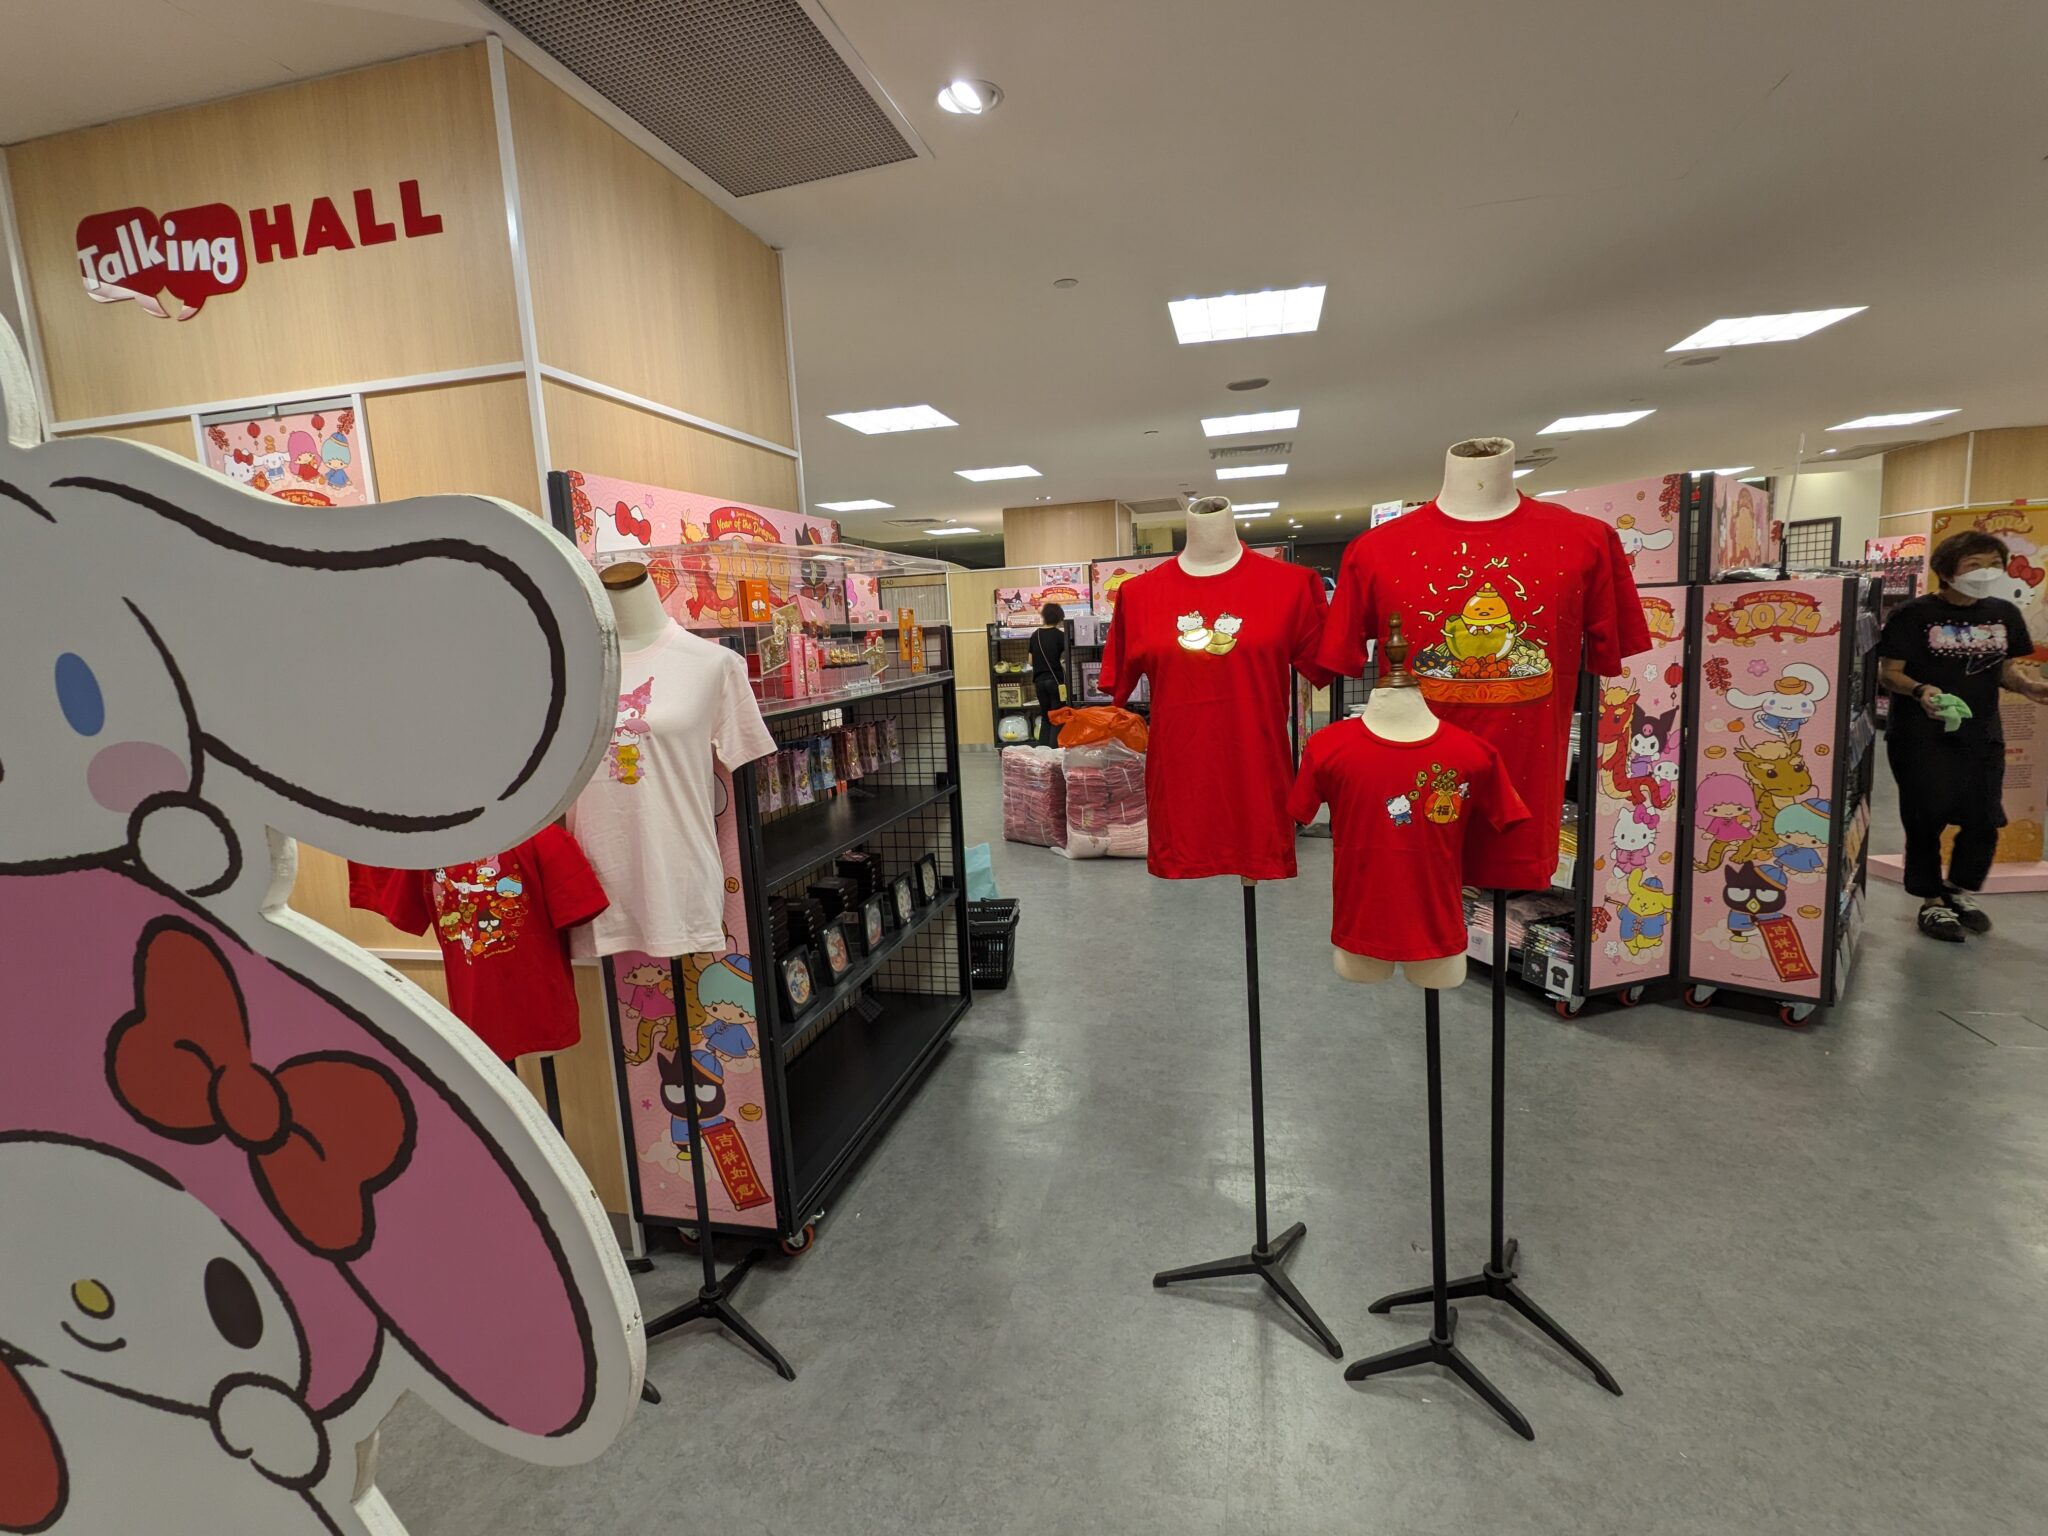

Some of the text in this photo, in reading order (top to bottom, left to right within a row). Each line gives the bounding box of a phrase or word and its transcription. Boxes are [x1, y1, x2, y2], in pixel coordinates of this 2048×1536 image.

[77, 179, 443, 290] Talking HALL
[717, 517, 776, 543] Year of the Dragon
[1732, 601, 1821, 634] 2024
[1771, 925, 1804, 974] 吉祥如意
[716, 1133, 756, 1200] 吉祥如意
